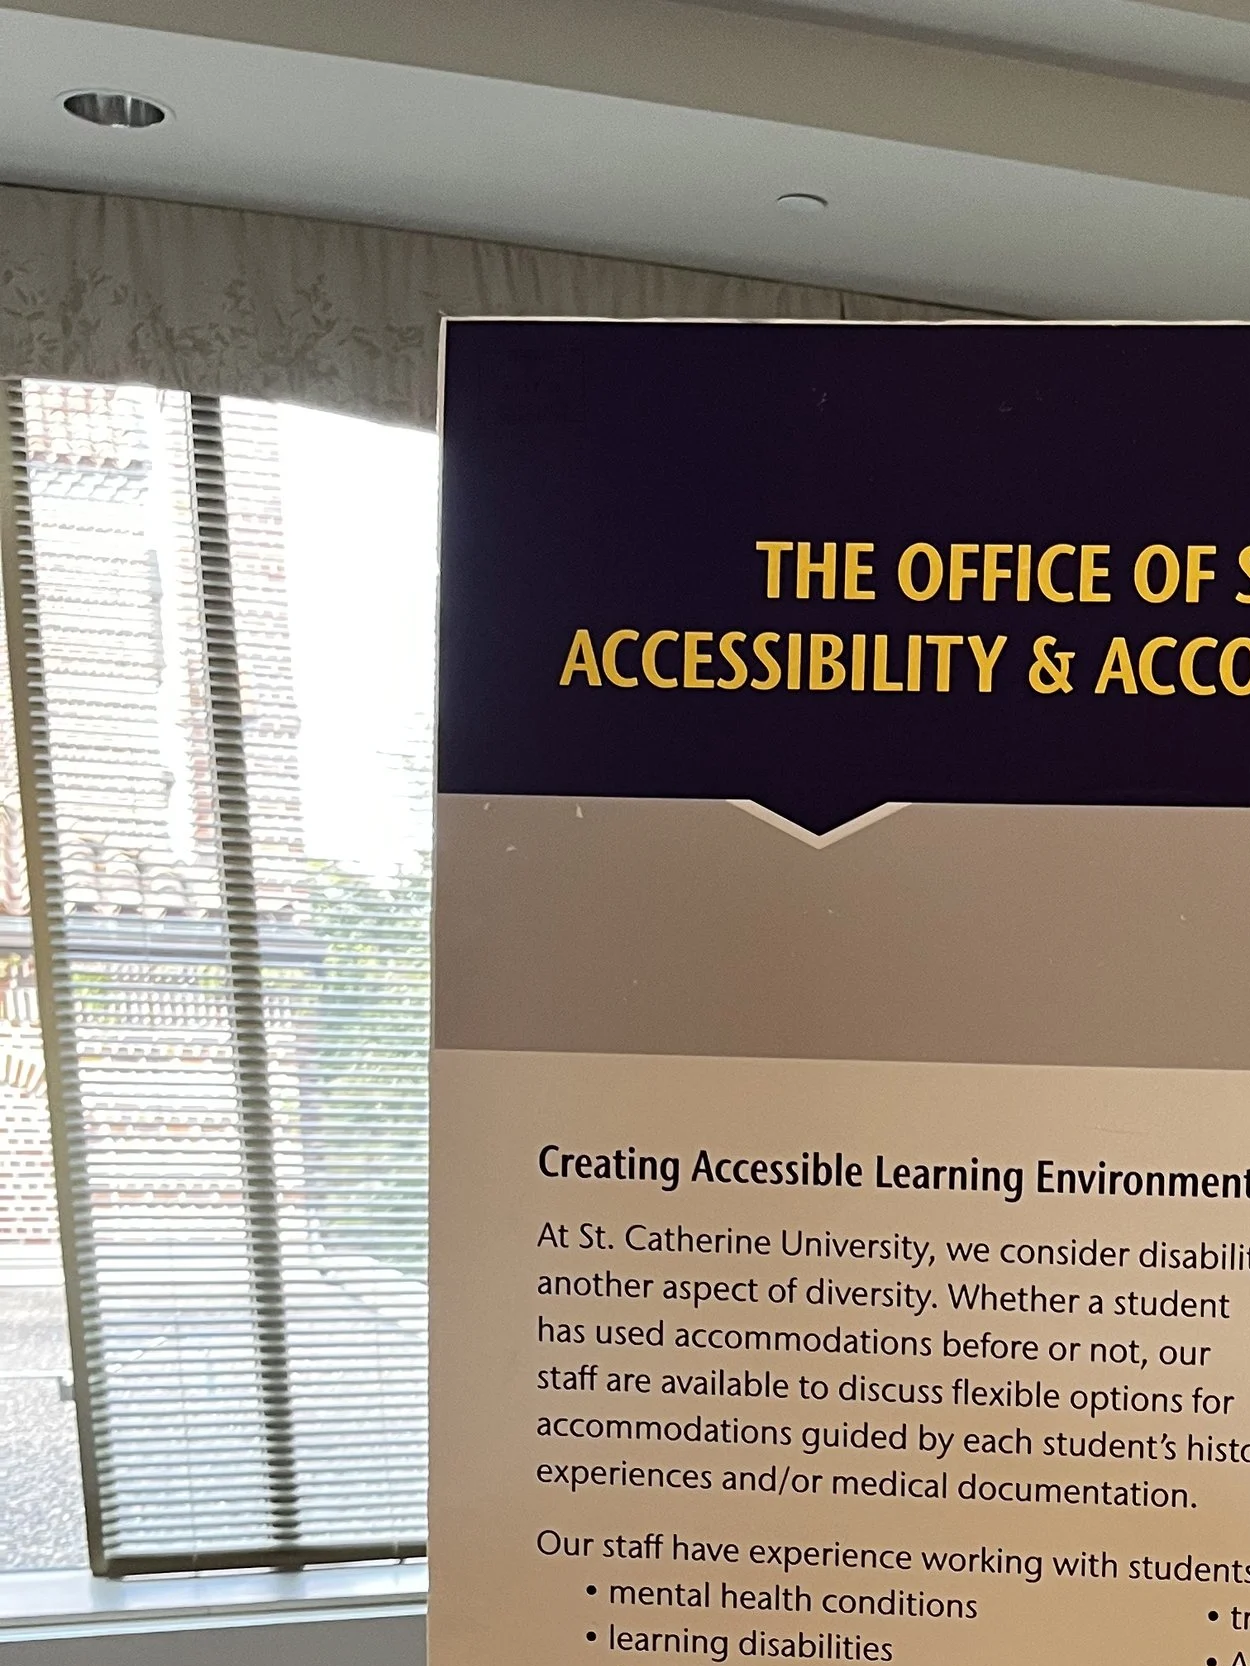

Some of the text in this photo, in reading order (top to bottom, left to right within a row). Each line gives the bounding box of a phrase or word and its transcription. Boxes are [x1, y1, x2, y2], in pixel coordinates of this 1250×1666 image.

[755, 540, 876, 600] THE
[897, 542, 1112, 603] OFFICE
[1133, 543, 1217, 604] OF
[559, 628, 1008, 693] ACCESSIBILITY
[1028, 635, 1076, 694] &
[538, 1144, 680, 1192] Creating
[690, 1149, 863, 1188] Accessible
[876, 1154, 1024, 1204] Learning
[536, 1221, 570, 1249] At
[578, 1222, 614, 1250] St.
[625, 1224, 772, 1256] Catherine
[781, 1229, 936, 1269] University,
[945, 1241, 990, 1263] we
[999, 1238, 1131, 1268] consider
[537, 1269, 1231, 1319] another aspect of diversity. Whether a student
[538, 1315, 1212, 1371] has used accommodations before or not, our
[536, 1364, 1236, 1419] staff are available to discuss flexible options for
[536, 1414, 792, 1446] accommodations
[801, 1421, 907, 1455] guided
[918, 1423, 955, 1460] by
[963, 1426, 1032, 1455] each
[536, 1459, 1197, 1509] experiences and/or medical documentation.
[536, 1529, 595, 1557] Our
[601, 1532, 665, 1560] staff
[672, 1533, 740, 1563] have
[749, 1541, 913, 1574] experience
[920, 1545, 1043, 1584] working
[1052, 1550, 1118, 1579] with
[609, 1580, 978, 1619] mental health conditions
[609, 1623, 893, 1663] learning disabilities
